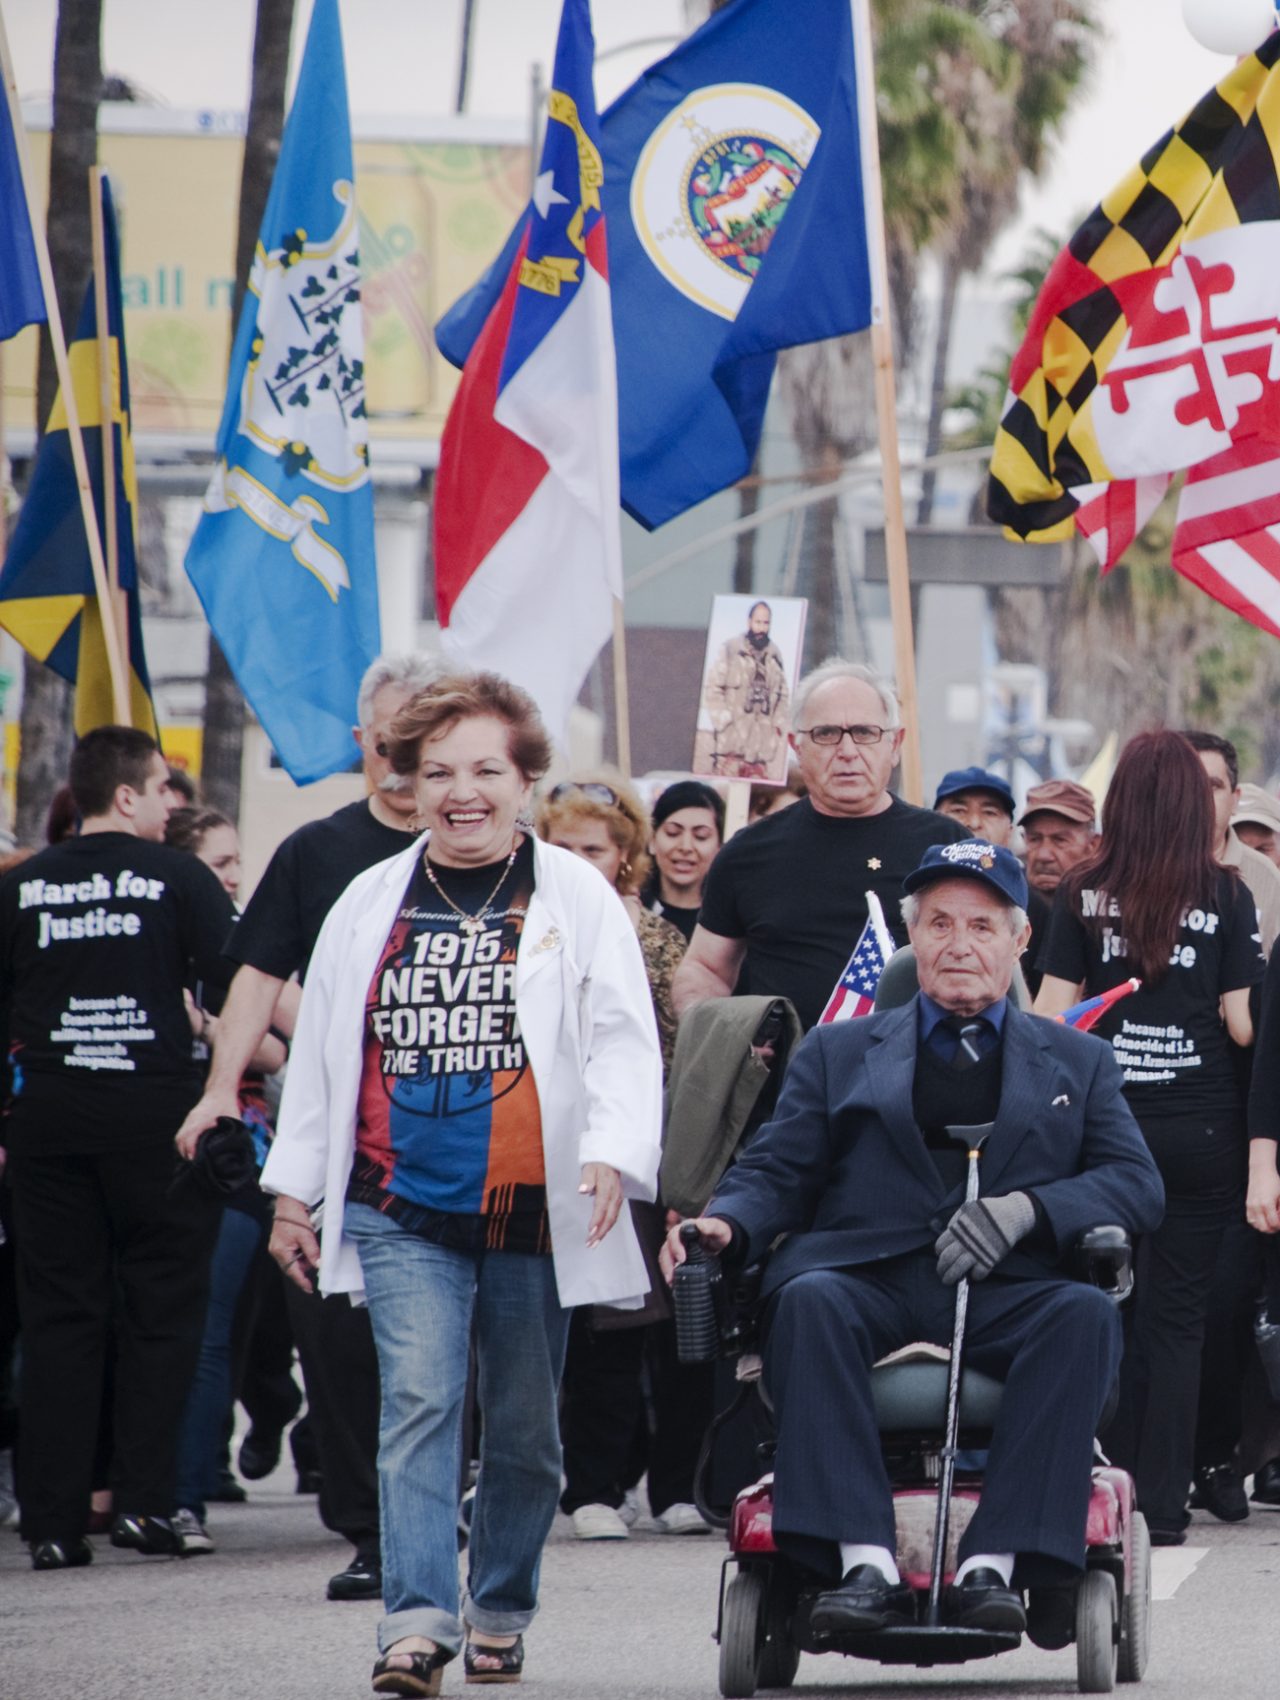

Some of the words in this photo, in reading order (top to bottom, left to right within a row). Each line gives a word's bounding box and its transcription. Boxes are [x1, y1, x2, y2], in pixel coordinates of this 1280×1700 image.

[19, 873, 111, 909] March
[116, 870, 164, 901] for
[38, 907, 141, 949] Justice
[413, 929, 503, 967] 1915
[381, 963, 517, 1006] NEVER
[372, 1005, 523, 1047] FORGET
[1112, 1034, 1165, 1053] Genocide
[382, 1049, 419, 1074] THE
[427, 1043, 523, 1074] TRUTH
[1113, 1050, 1142, 1066] llion
[1142, 1054, 1202, 1068] Armenians
